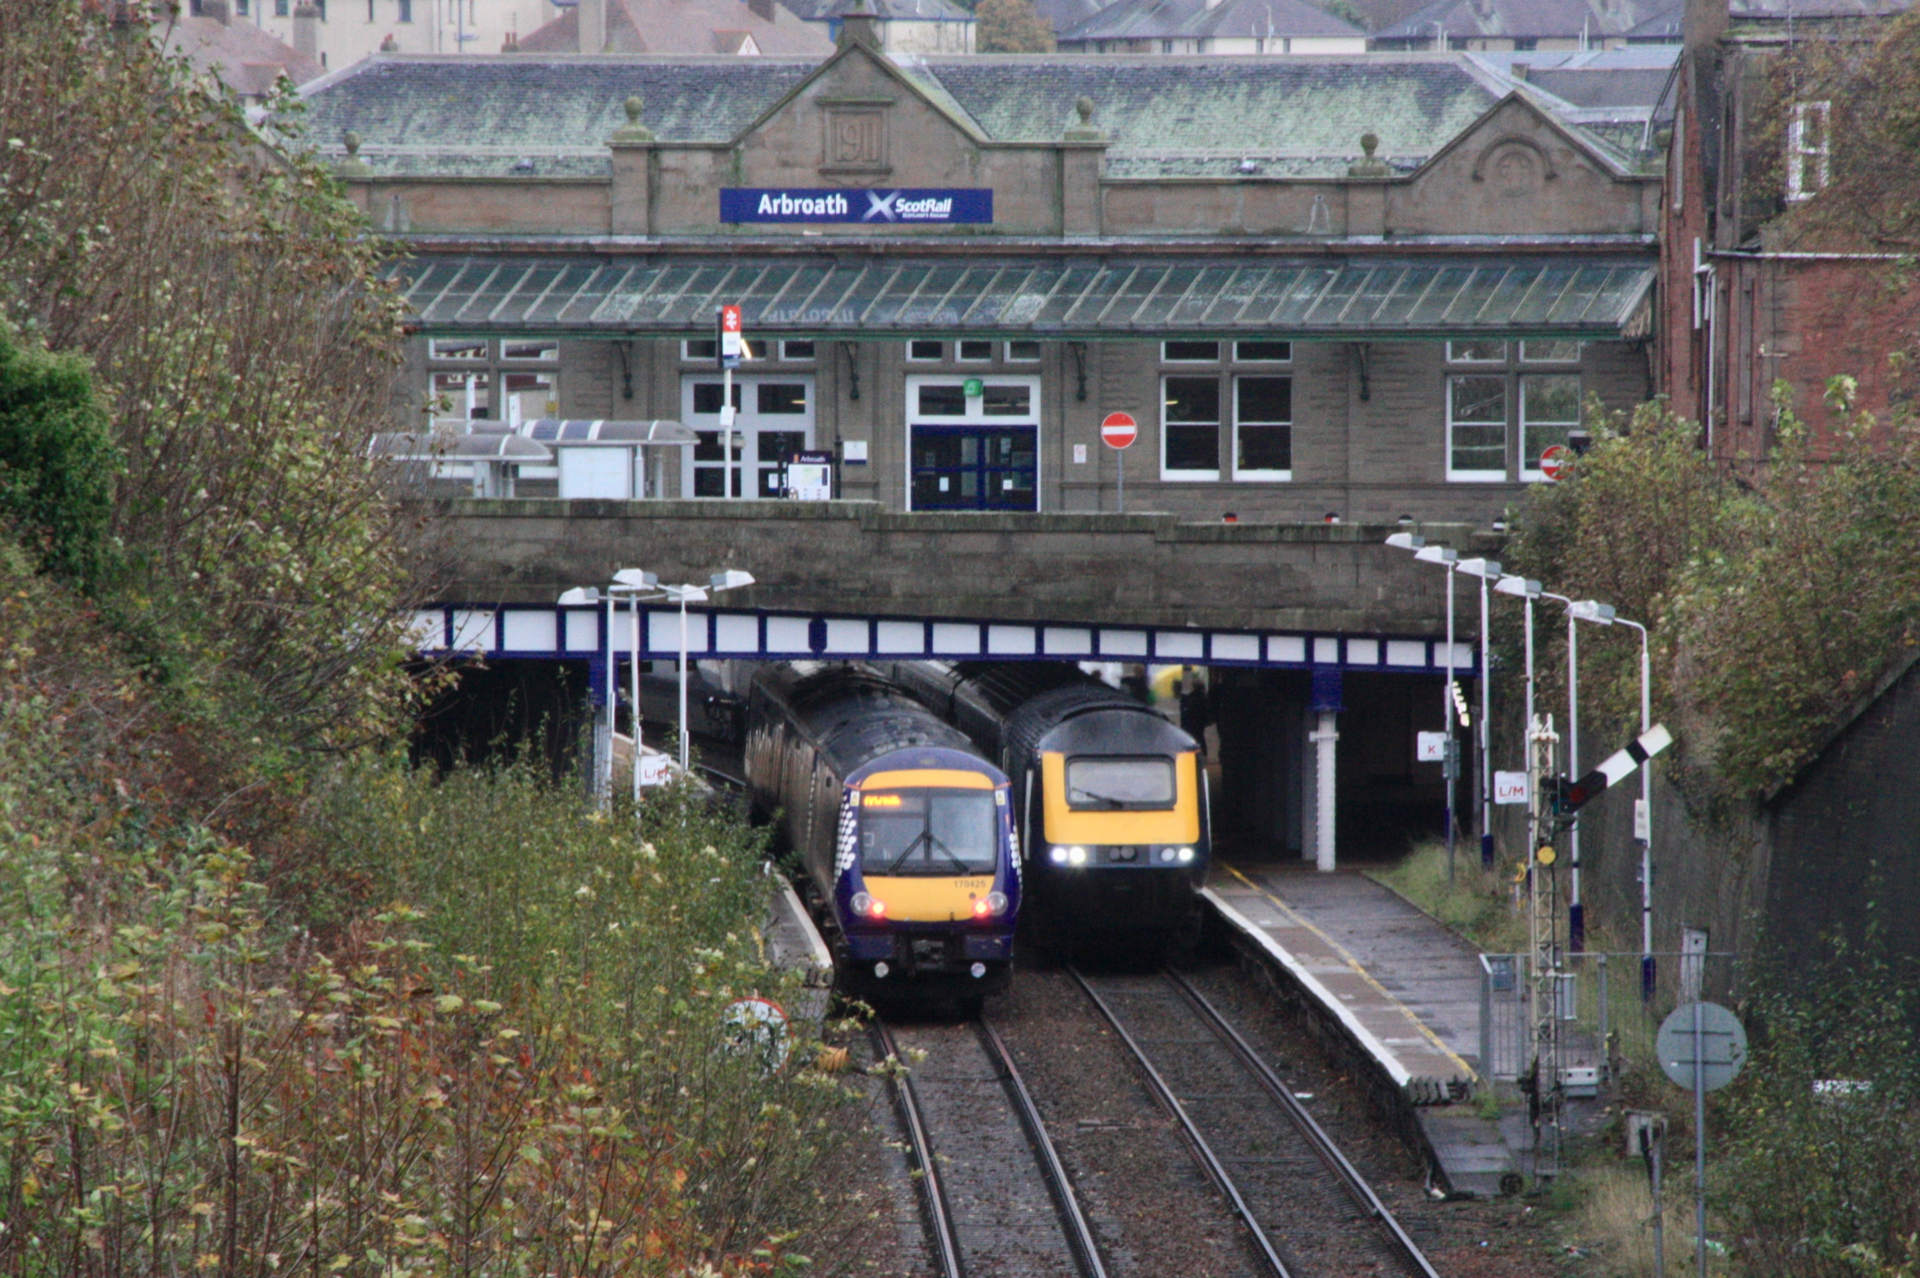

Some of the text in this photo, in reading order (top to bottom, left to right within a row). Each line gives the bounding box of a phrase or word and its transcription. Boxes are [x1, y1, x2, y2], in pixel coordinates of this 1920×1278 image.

[757, 193, 848, 215] Arbroath
[895, 197, 952, 213] ScotRail
[1428, 745, 1436, 755] K
[1499, 786, 1524, 797] L/M
[954, 880, 986, 888] 170425
